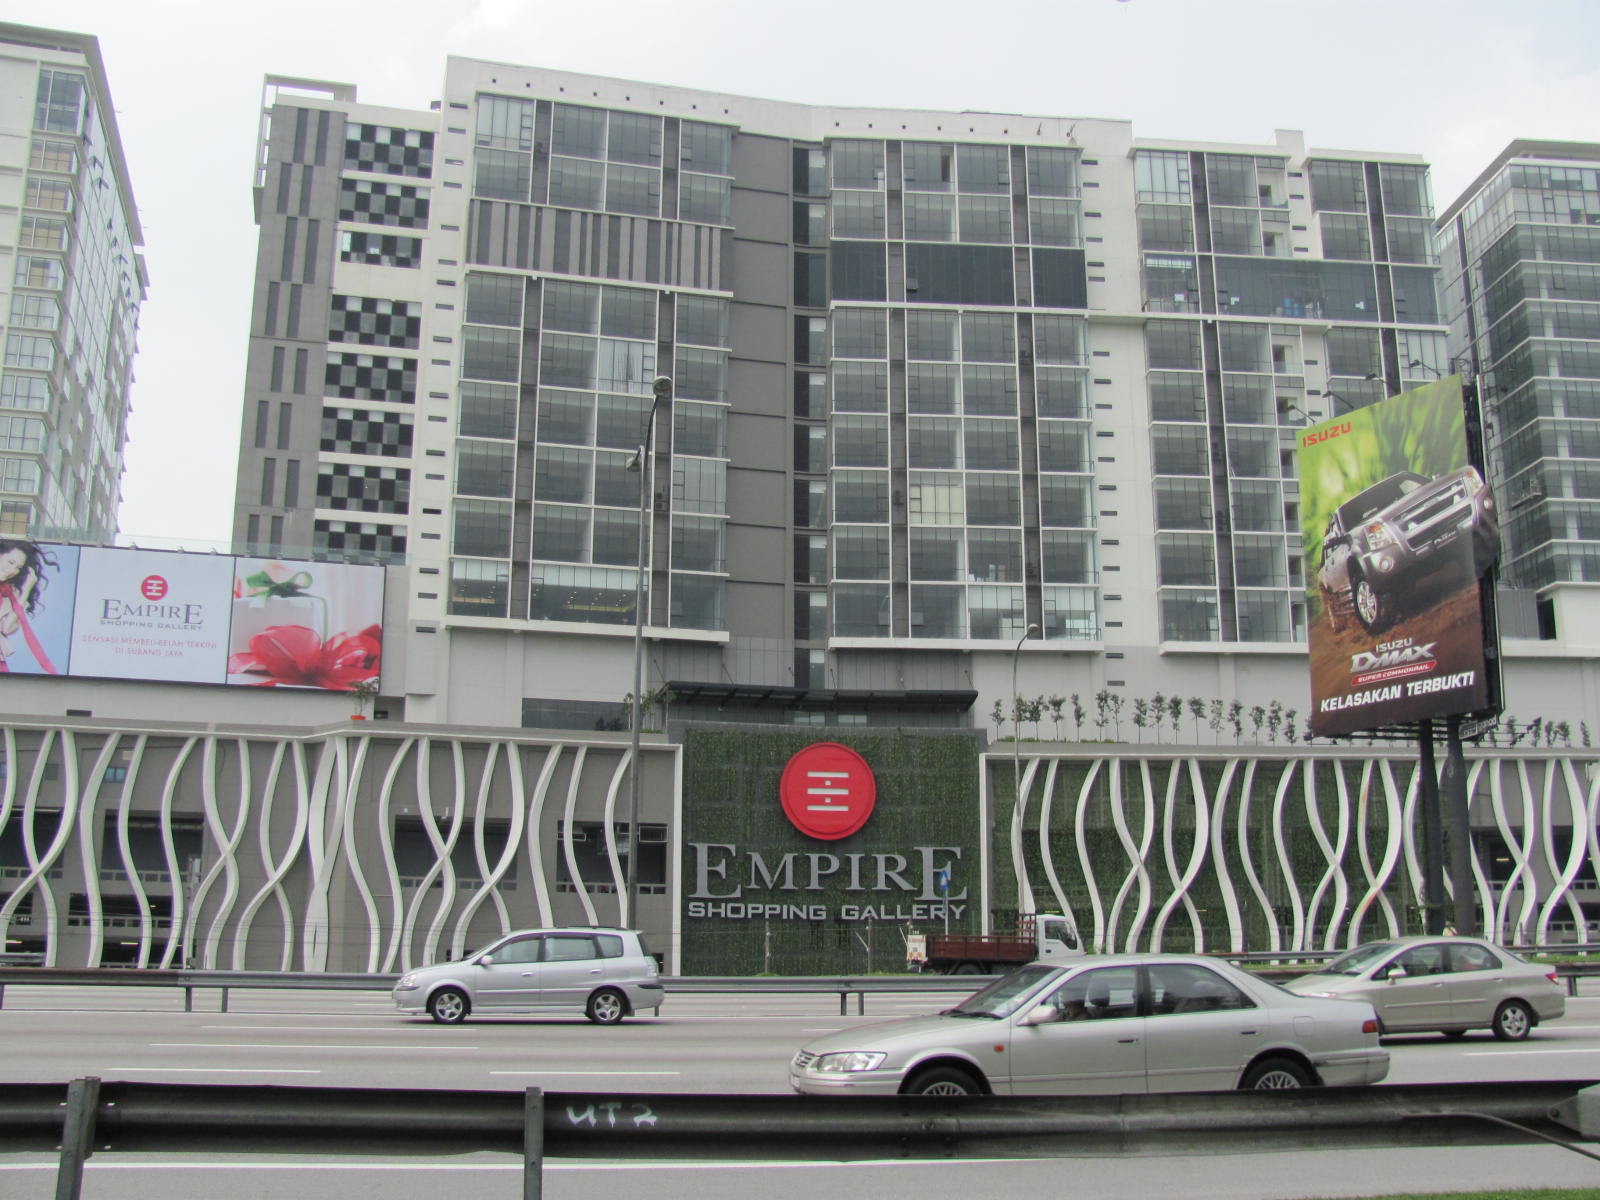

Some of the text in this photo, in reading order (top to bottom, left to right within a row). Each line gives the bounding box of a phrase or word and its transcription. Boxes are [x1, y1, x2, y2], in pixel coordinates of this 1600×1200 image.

[1302, 421, 1352, 448] ISUZU
[101, 598, 204, 625] EMPIRE
[100, 620, 202, 631] SHOPPING GALLERY
[1375, 637, 1413, 653] ISUZU
[1357, 673, 1382, 683] SUPER
[1320, 671, 1475, 713] KELASAKAN TERBUKTI
[687, 842, 968, 900] EMPIRE
[688, 902, 967, 921] SHOPPING GALLERY
